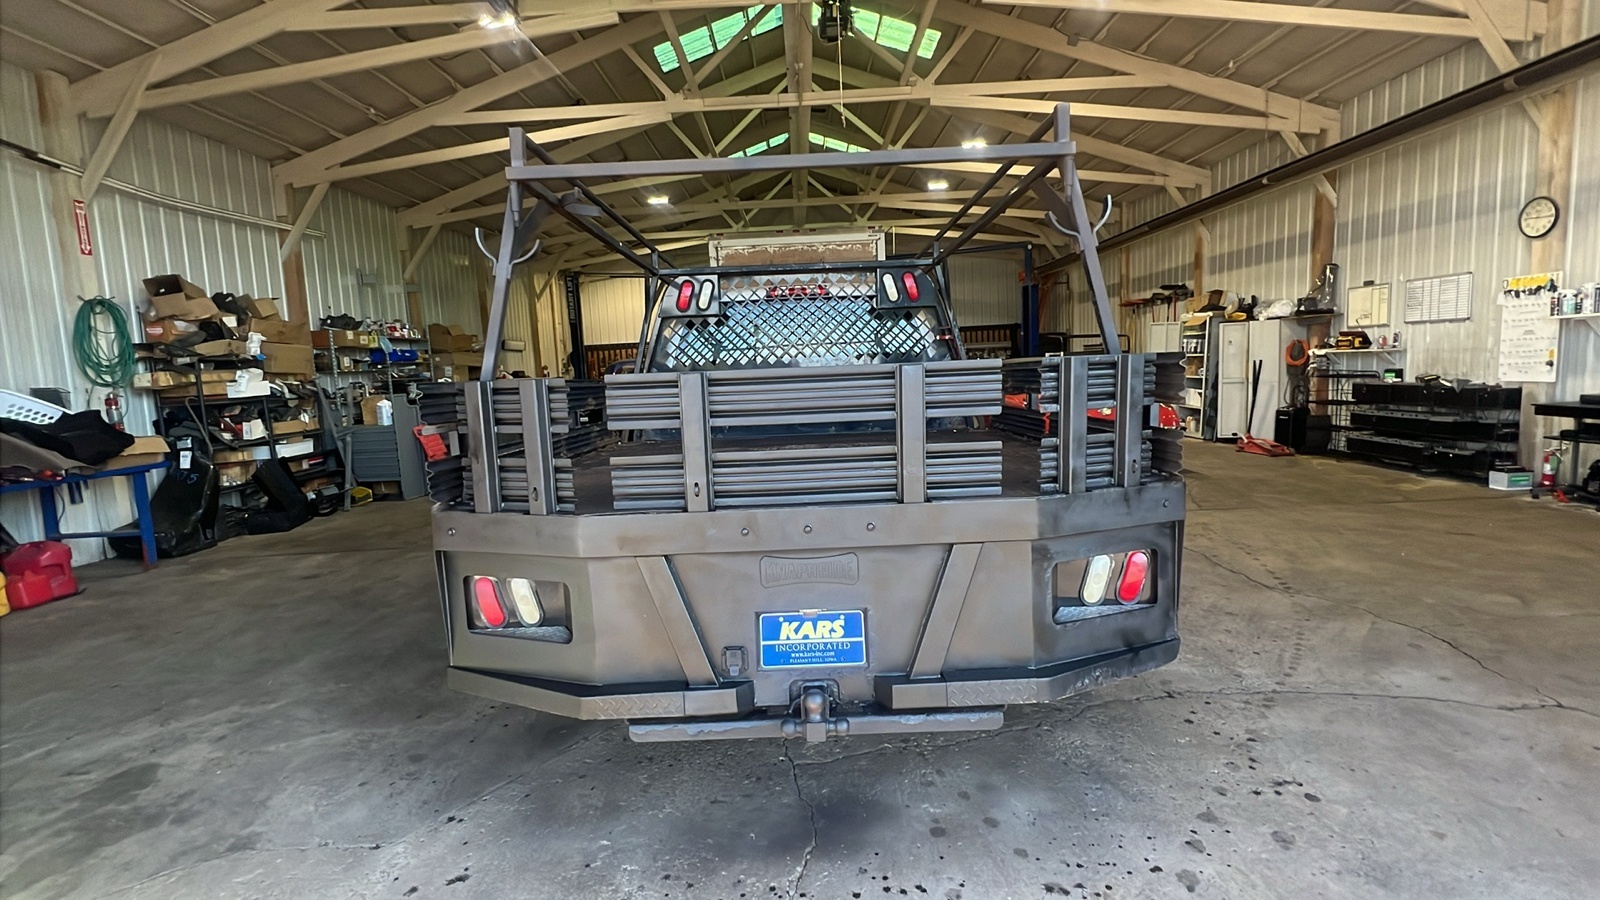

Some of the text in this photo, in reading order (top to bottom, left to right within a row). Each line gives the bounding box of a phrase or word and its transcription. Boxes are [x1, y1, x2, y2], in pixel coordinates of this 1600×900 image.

[765, 560, 853, 584] KNAPHEIDE
[779, 619, 845, 640] KARS
[775, 641, 851, 652] INCORPORATED
